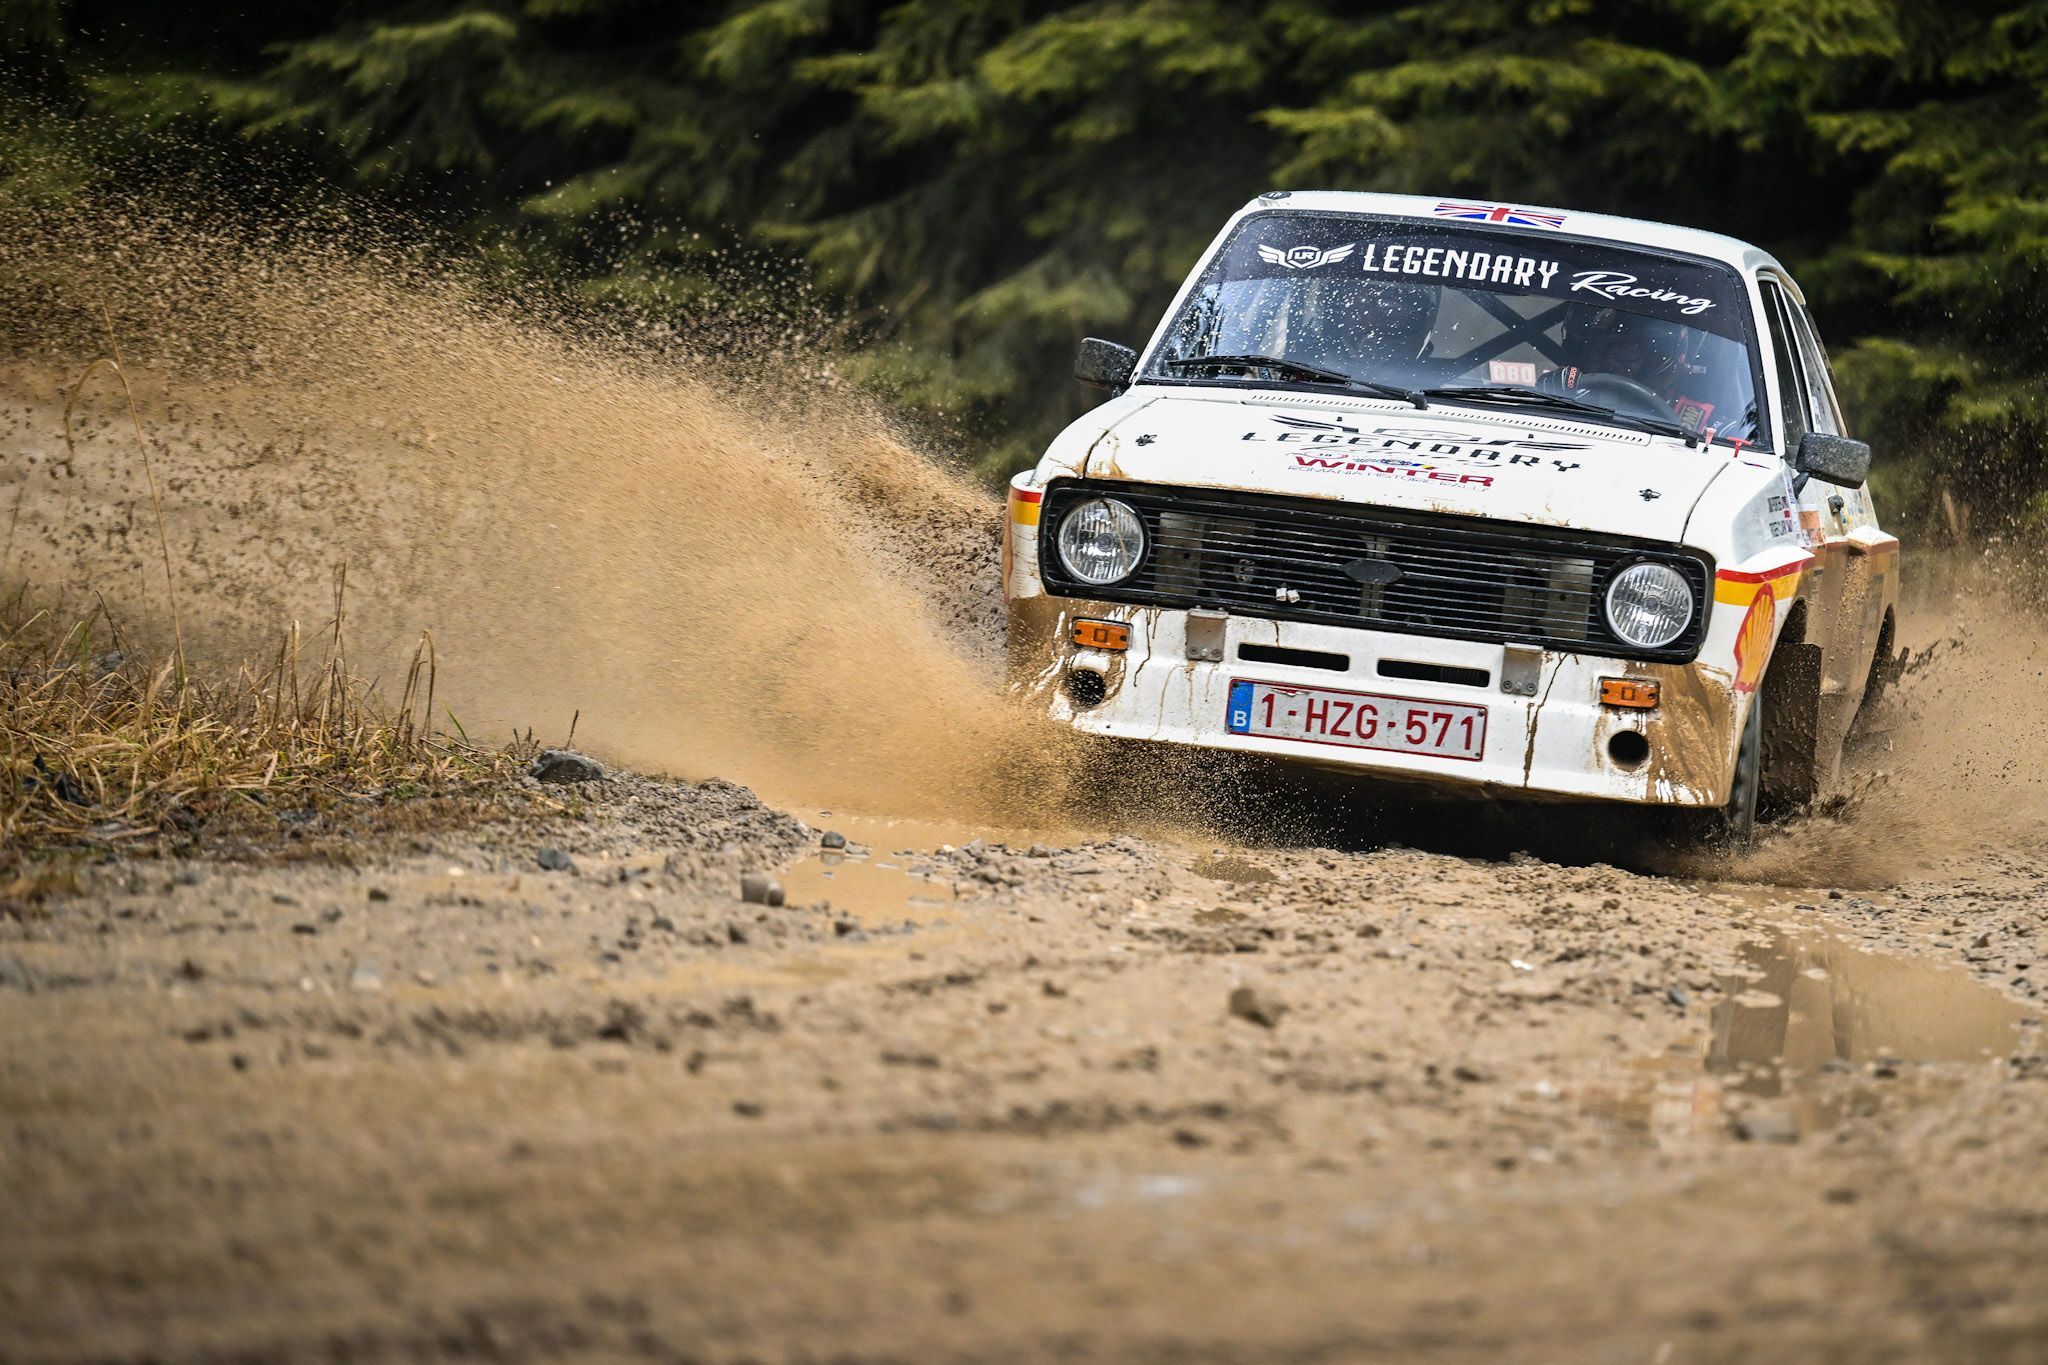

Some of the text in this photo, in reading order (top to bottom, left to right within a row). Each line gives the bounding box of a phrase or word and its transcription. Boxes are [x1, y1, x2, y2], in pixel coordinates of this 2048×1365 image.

[1362, 243, 1717, 314] LEGENDARY Racing
[1241, 431, 1582, 472] LEGENDARY
[1288, 465, 1362, 476] ROMANIA
[1295, 456, 1494, 487] WINTER
[1232, 710, 1248, 727] B
